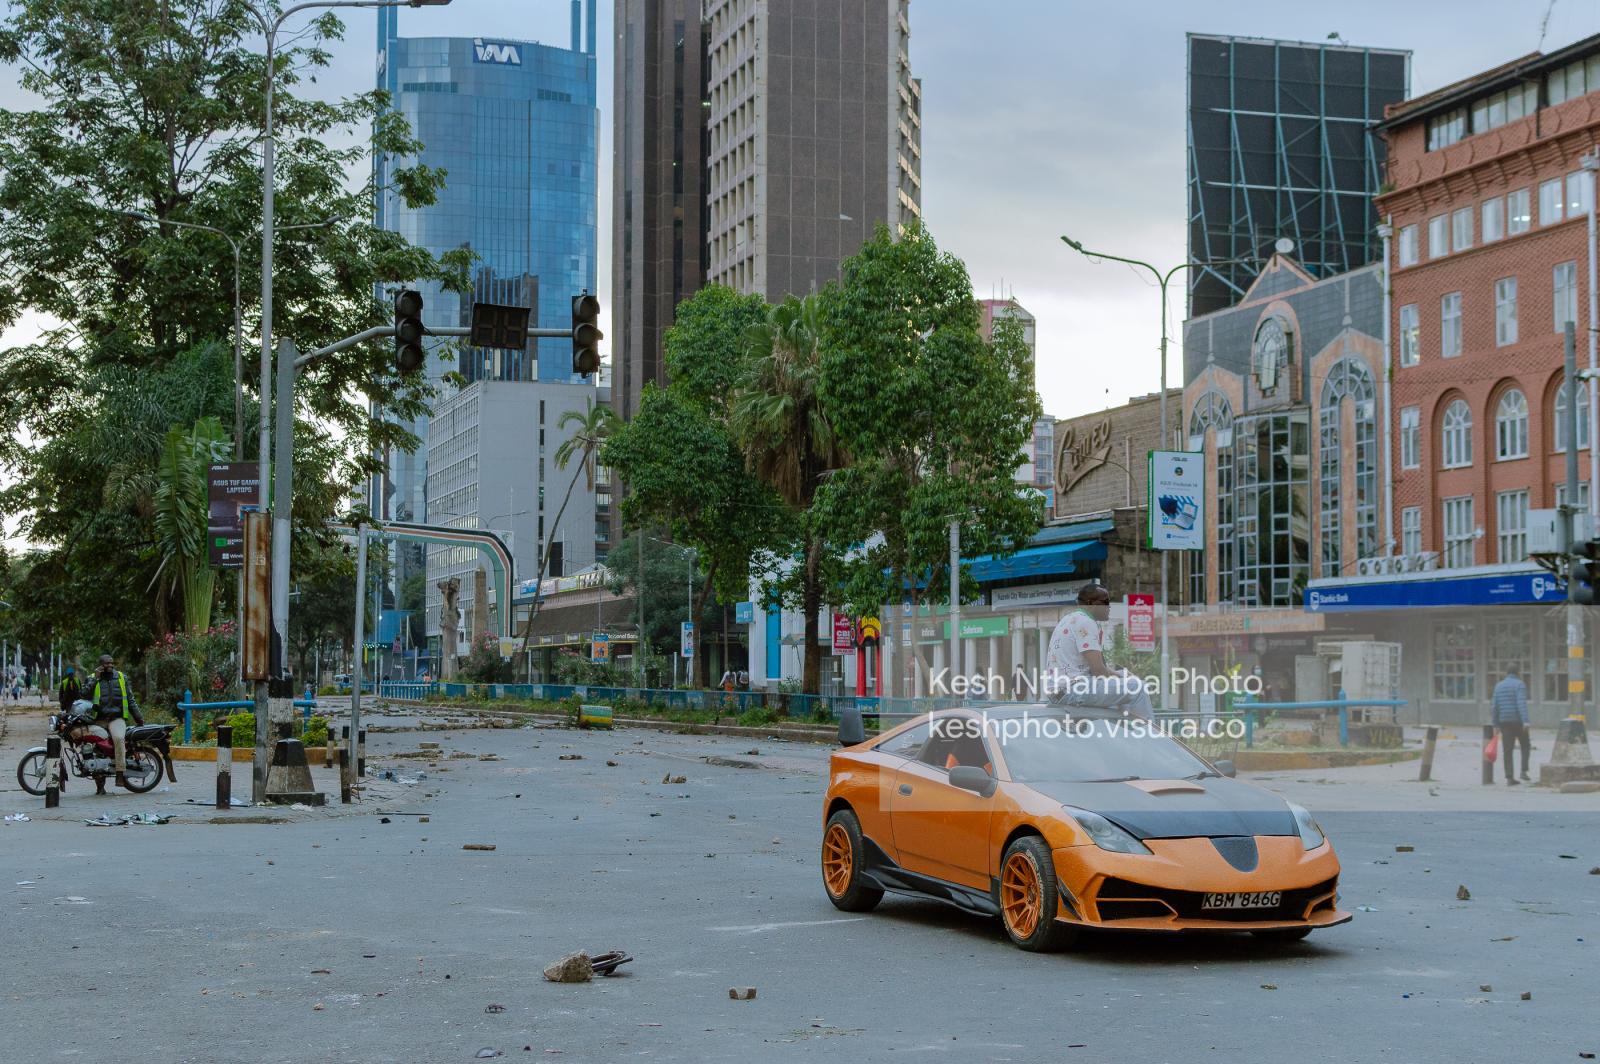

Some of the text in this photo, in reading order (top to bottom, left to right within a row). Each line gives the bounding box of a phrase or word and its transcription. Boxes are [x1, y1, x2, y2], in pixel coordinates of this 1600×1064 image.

[226, 486, 252, 494] LAPTOPS
[1203, 891, 1280, 908] KBM 846G
